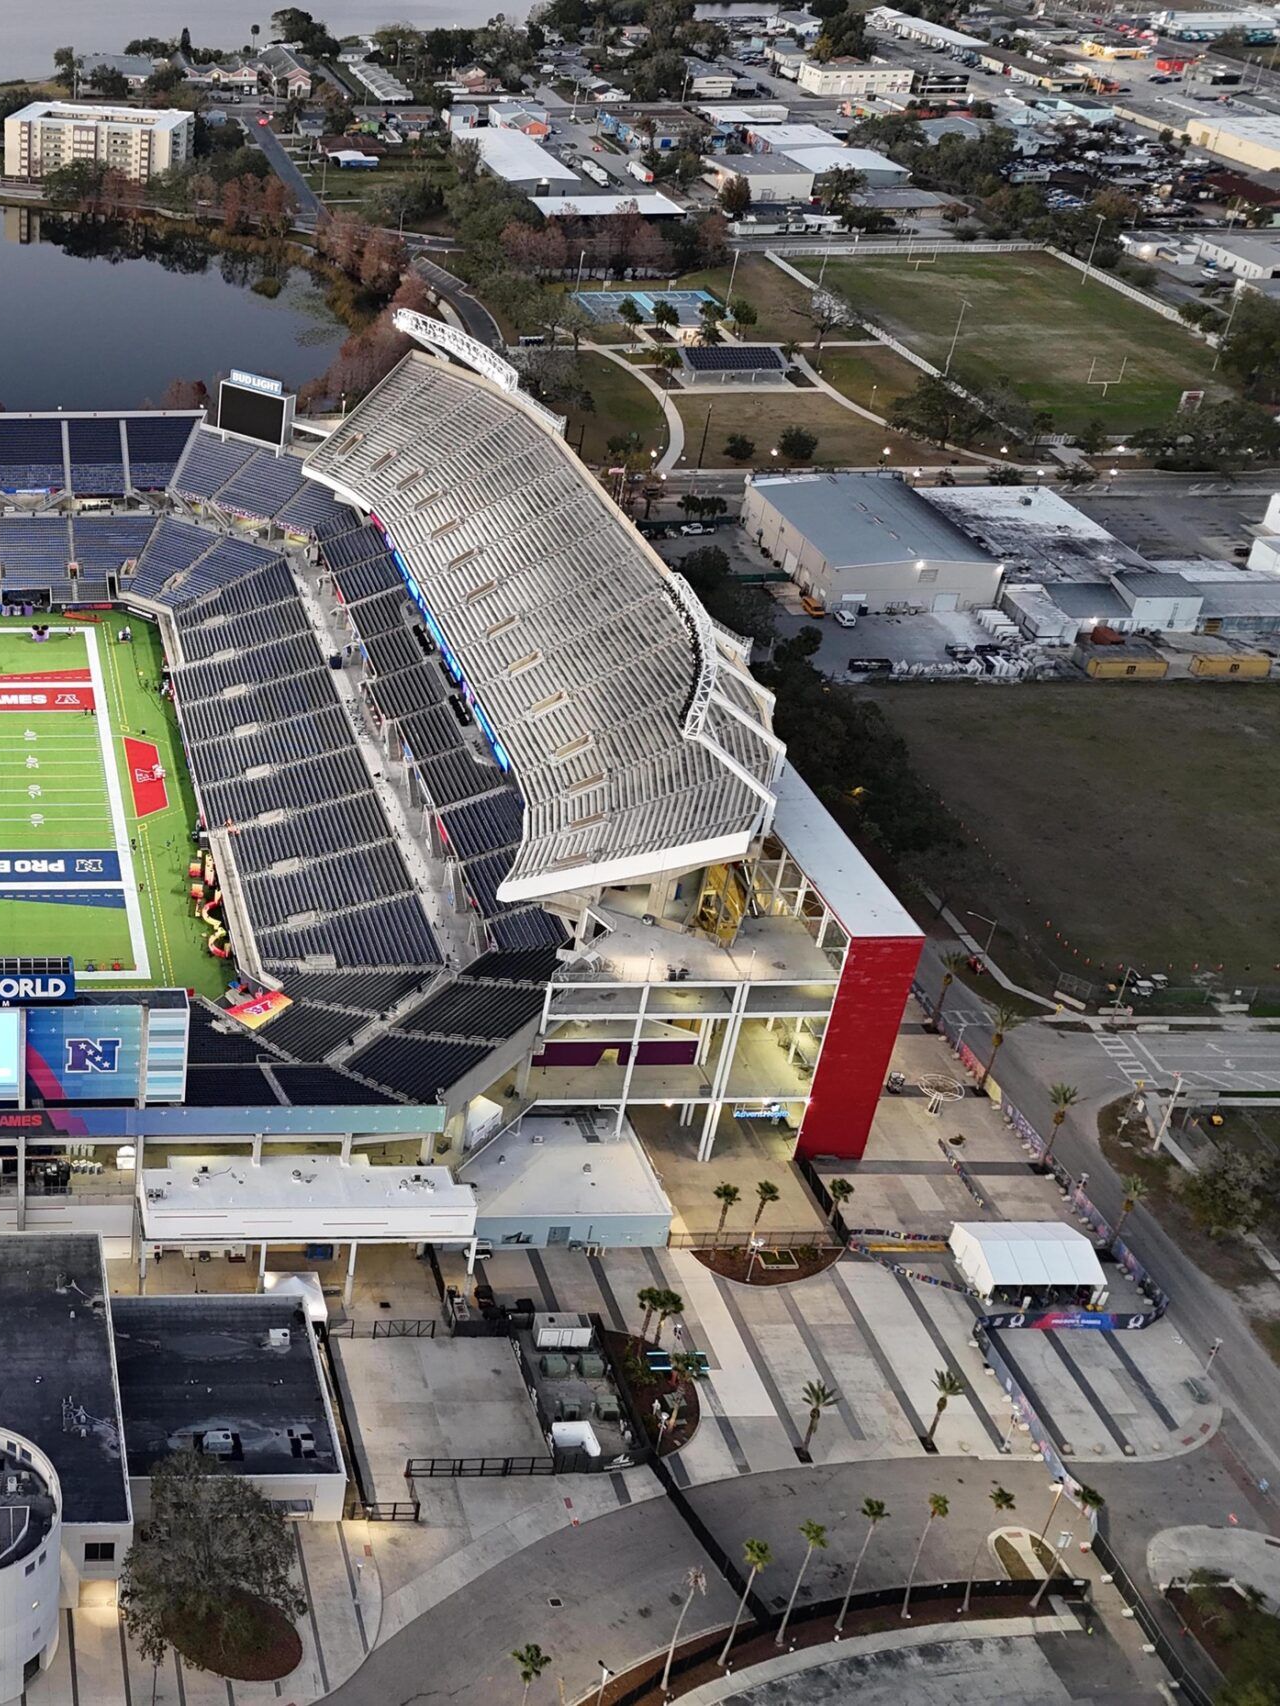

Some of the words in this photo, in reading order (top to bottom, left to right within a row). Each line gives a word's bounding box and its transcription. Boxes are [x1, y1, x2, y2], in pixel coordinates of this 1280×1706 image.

[232, 372, 251, 384] BUD
[252, 377, 280, 392] LIGHT
[14, 859, 65, 873] PRO
[64, 1037, 122, 1073] N
